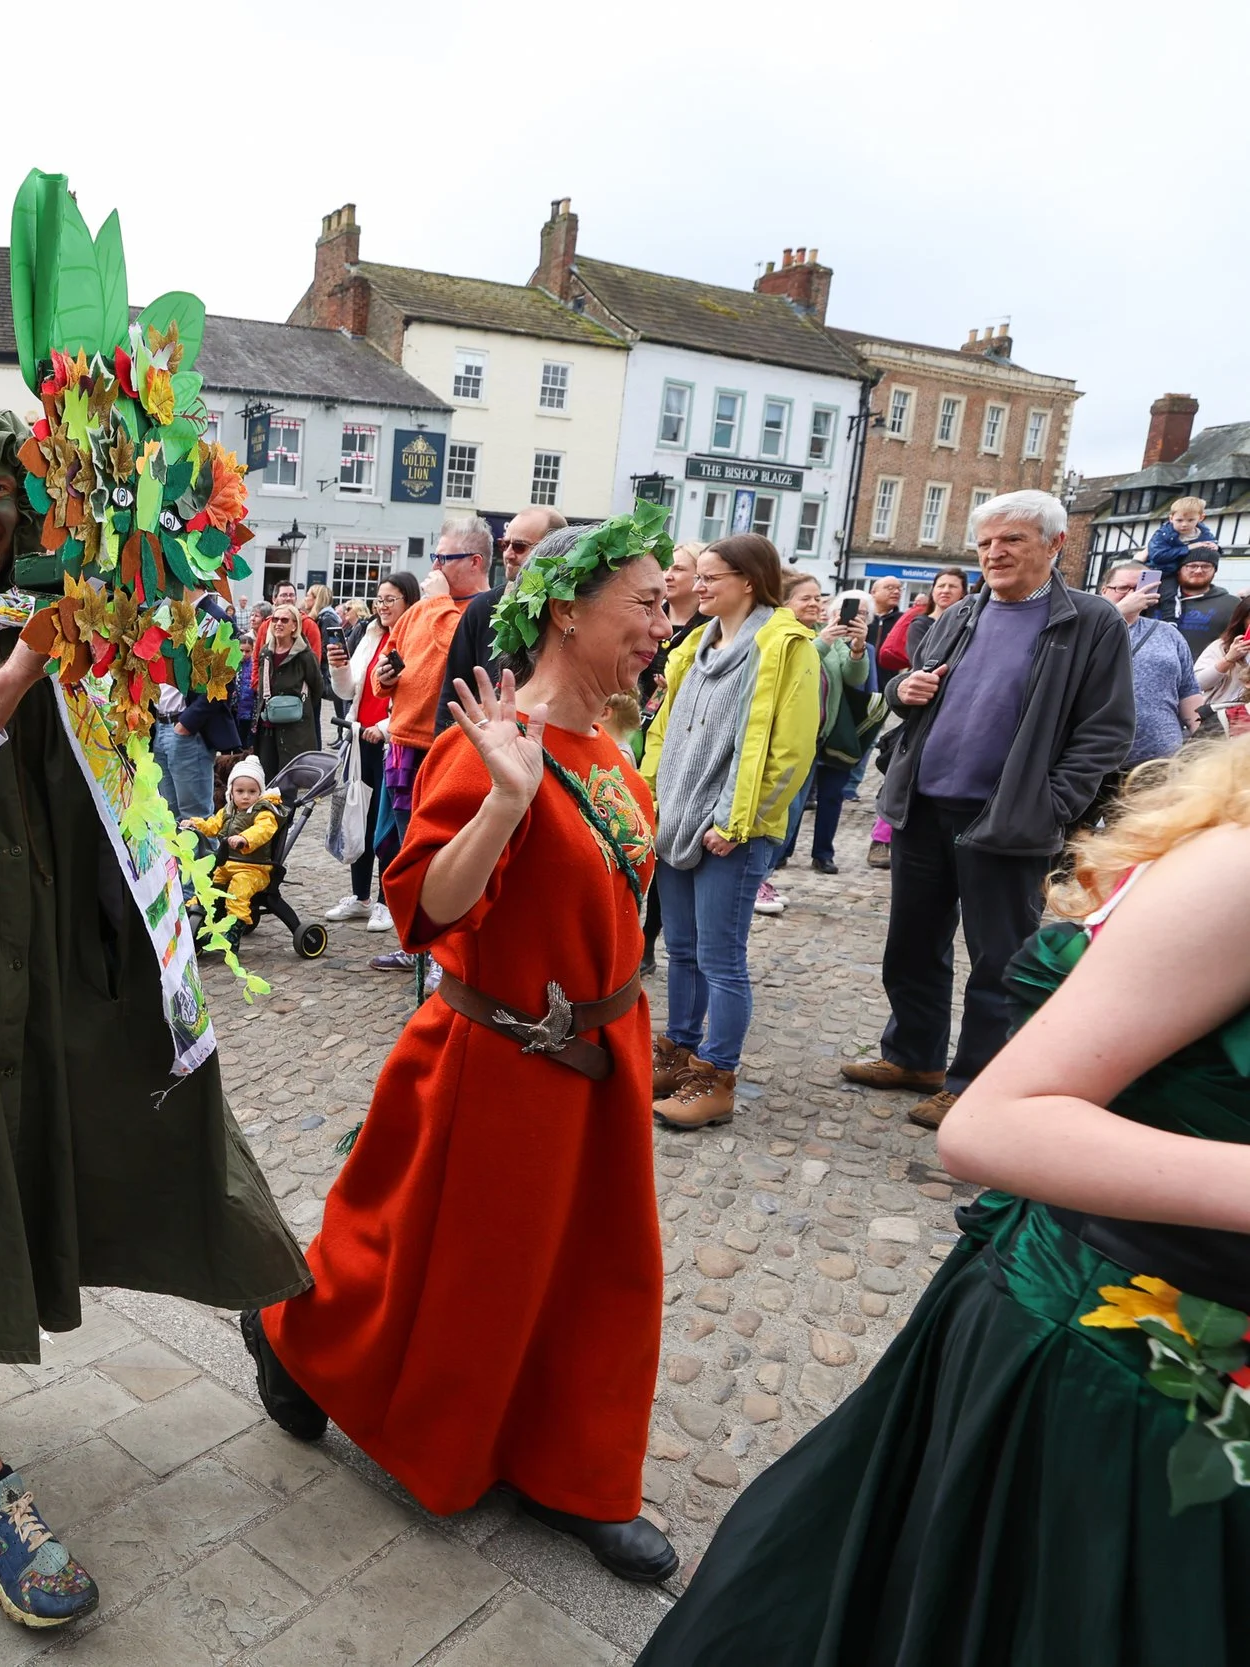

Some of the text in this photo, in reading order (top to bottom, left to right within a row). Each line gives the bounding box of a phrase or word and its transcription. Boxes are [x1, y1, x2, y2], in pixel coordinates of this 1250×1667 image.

[402, 452, 437, 468] GOLDEN
[408, 466, 429, 480] LION
[700, 464, 793, 485] THE BISHOP BLAIZE
